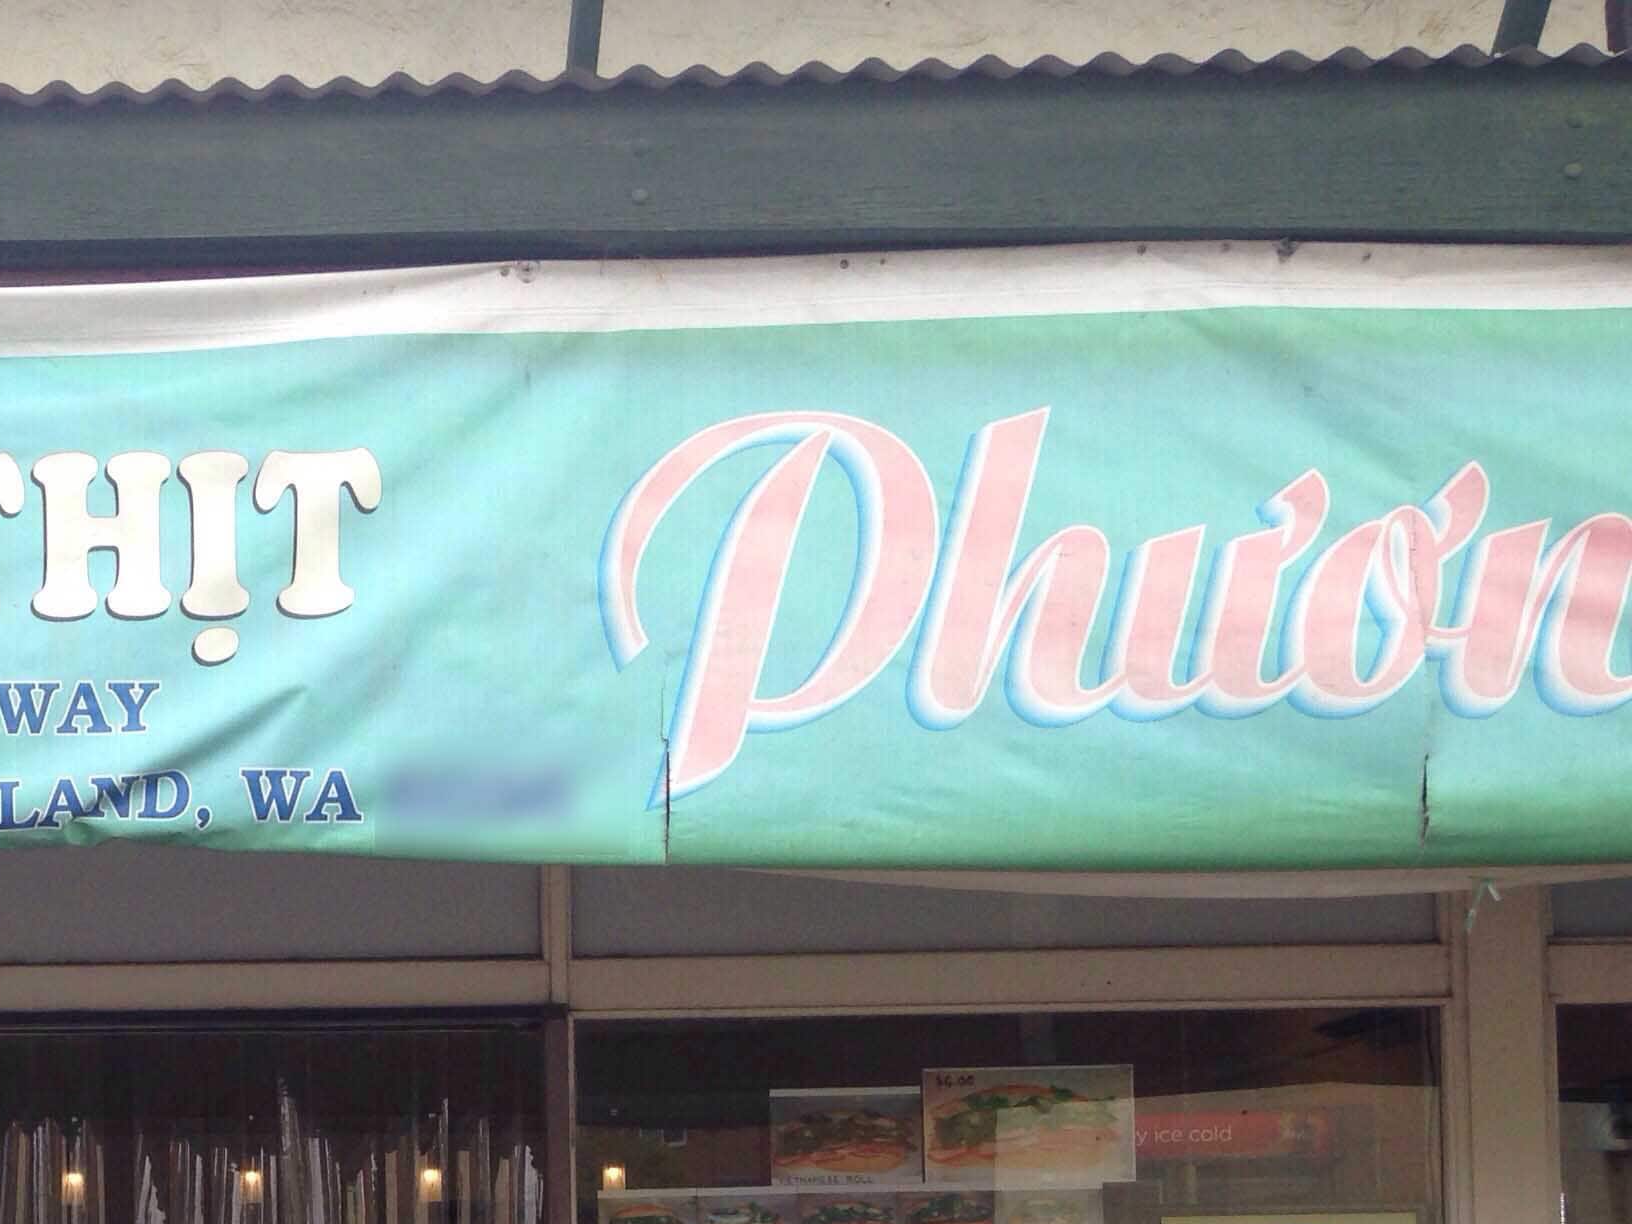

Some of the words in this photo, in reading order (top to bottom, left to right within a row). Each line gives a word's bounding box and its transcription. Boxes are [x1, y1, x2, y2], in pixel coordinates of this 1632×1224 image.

[598, 406, 1632, 812] Phươn
[239, 766, 364, 824] WA
[1154, 1127, 1184, 1142] ice
[1188, 1126, 1233, 1142] cold
